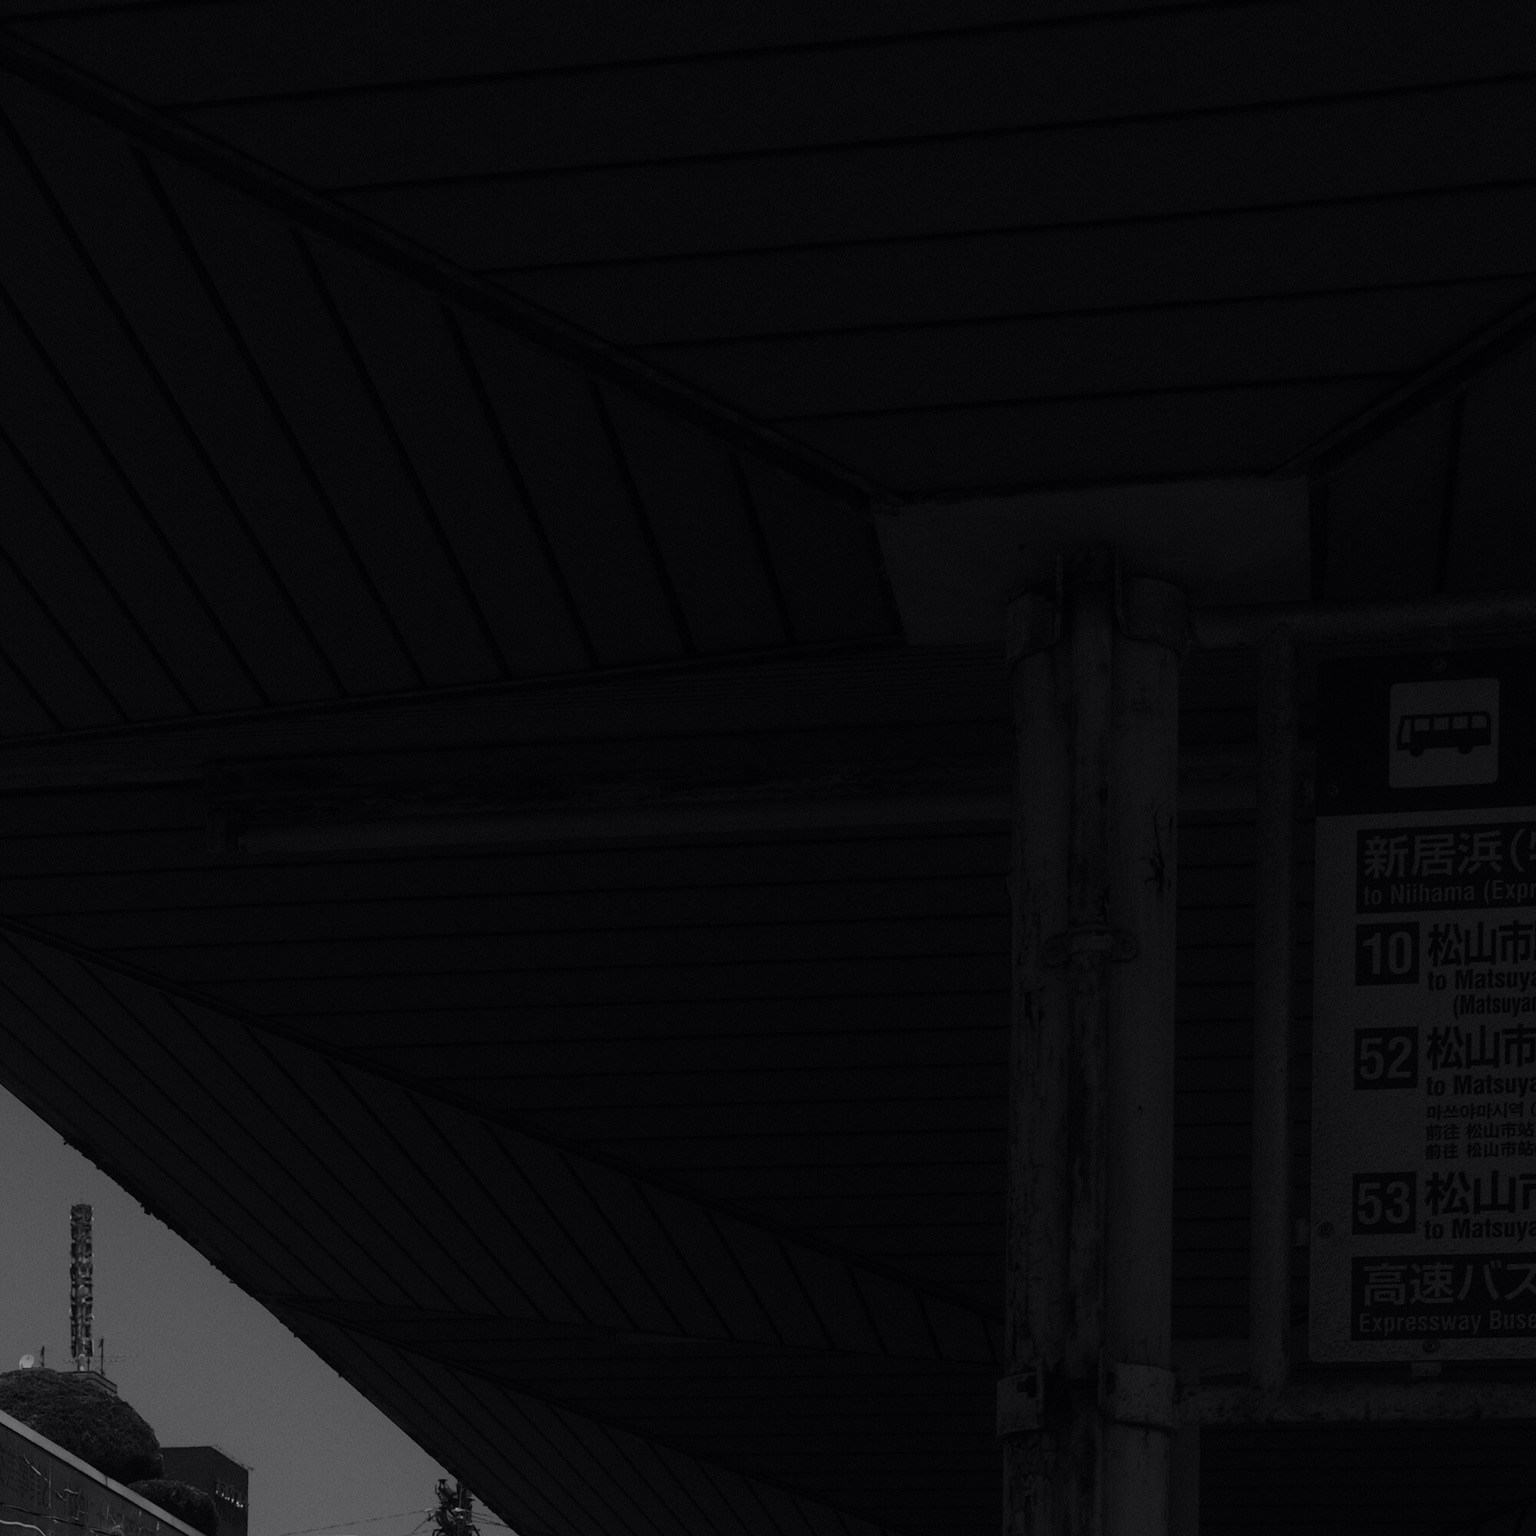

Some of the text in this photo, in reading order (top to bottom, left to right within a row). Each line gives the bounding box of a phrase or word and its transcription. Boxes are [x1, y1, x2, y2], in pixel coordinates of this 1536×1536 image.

[1363, 886, 1382, 905] to
[1390, 883, 1475, 904] Niihama
[1362, 930, 1413, 975] 10
[1427, 972, 1447, 991] to
[1359, 1024, 1536, 1081] 52 松山市
[1426, 1077, 1446, 1096] to
[1425, 1121, 1535, 1141] 前往 松山市站
[1425, 1143, 1460, 1160] 前往
[1356, 1180, 1411, 1225] 53
[1424, 1220, 1444, 1240] to
[1362, 1260, 1536, 1307] 高速バス
[1359, 1312, 1482, 1336] Expressway
